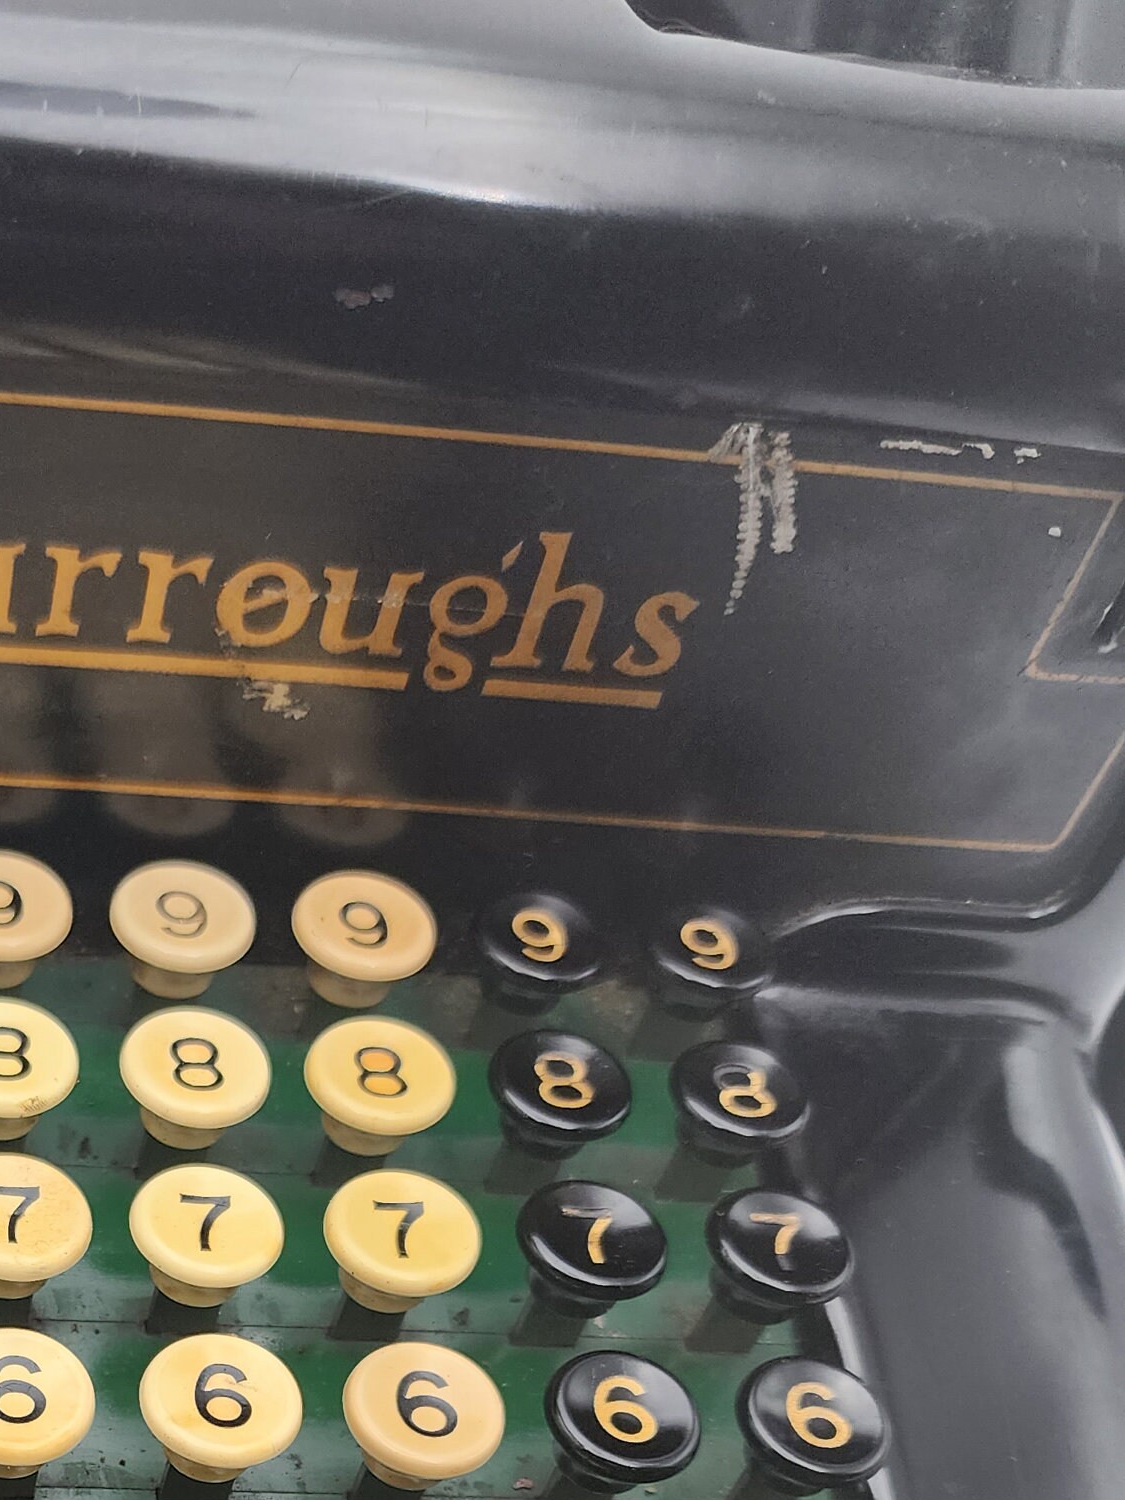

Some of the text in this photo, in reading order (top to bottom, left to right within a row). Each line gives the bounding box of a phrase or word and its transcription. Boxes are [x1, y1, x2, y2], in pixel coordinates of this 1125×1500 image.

[156, 891, 207, 936] 9
[339, 902, 387, 946] 9
[511, 907, 569, 962] 9
[680, 918, 738, 970] 9
[171, 1037, 223, 1089] 8
[355, 1046, 407, 1097] 8
[534, 1051, 595, 1108] 8
[713, 1063, 777, 1118] 8
[180, 1193, 231, 1251] 7
[373, 1201, 423, 1258] 7
[561, 1206, 613, 1264] 7
[749, 1212, 801, 1271] 7
[195, 1364, 252, 1428] 6
[397, 1370, 457, 1437] 6
[593, 1374, 657, 1442] 6
[785, 1381, 851, 1448] 6
